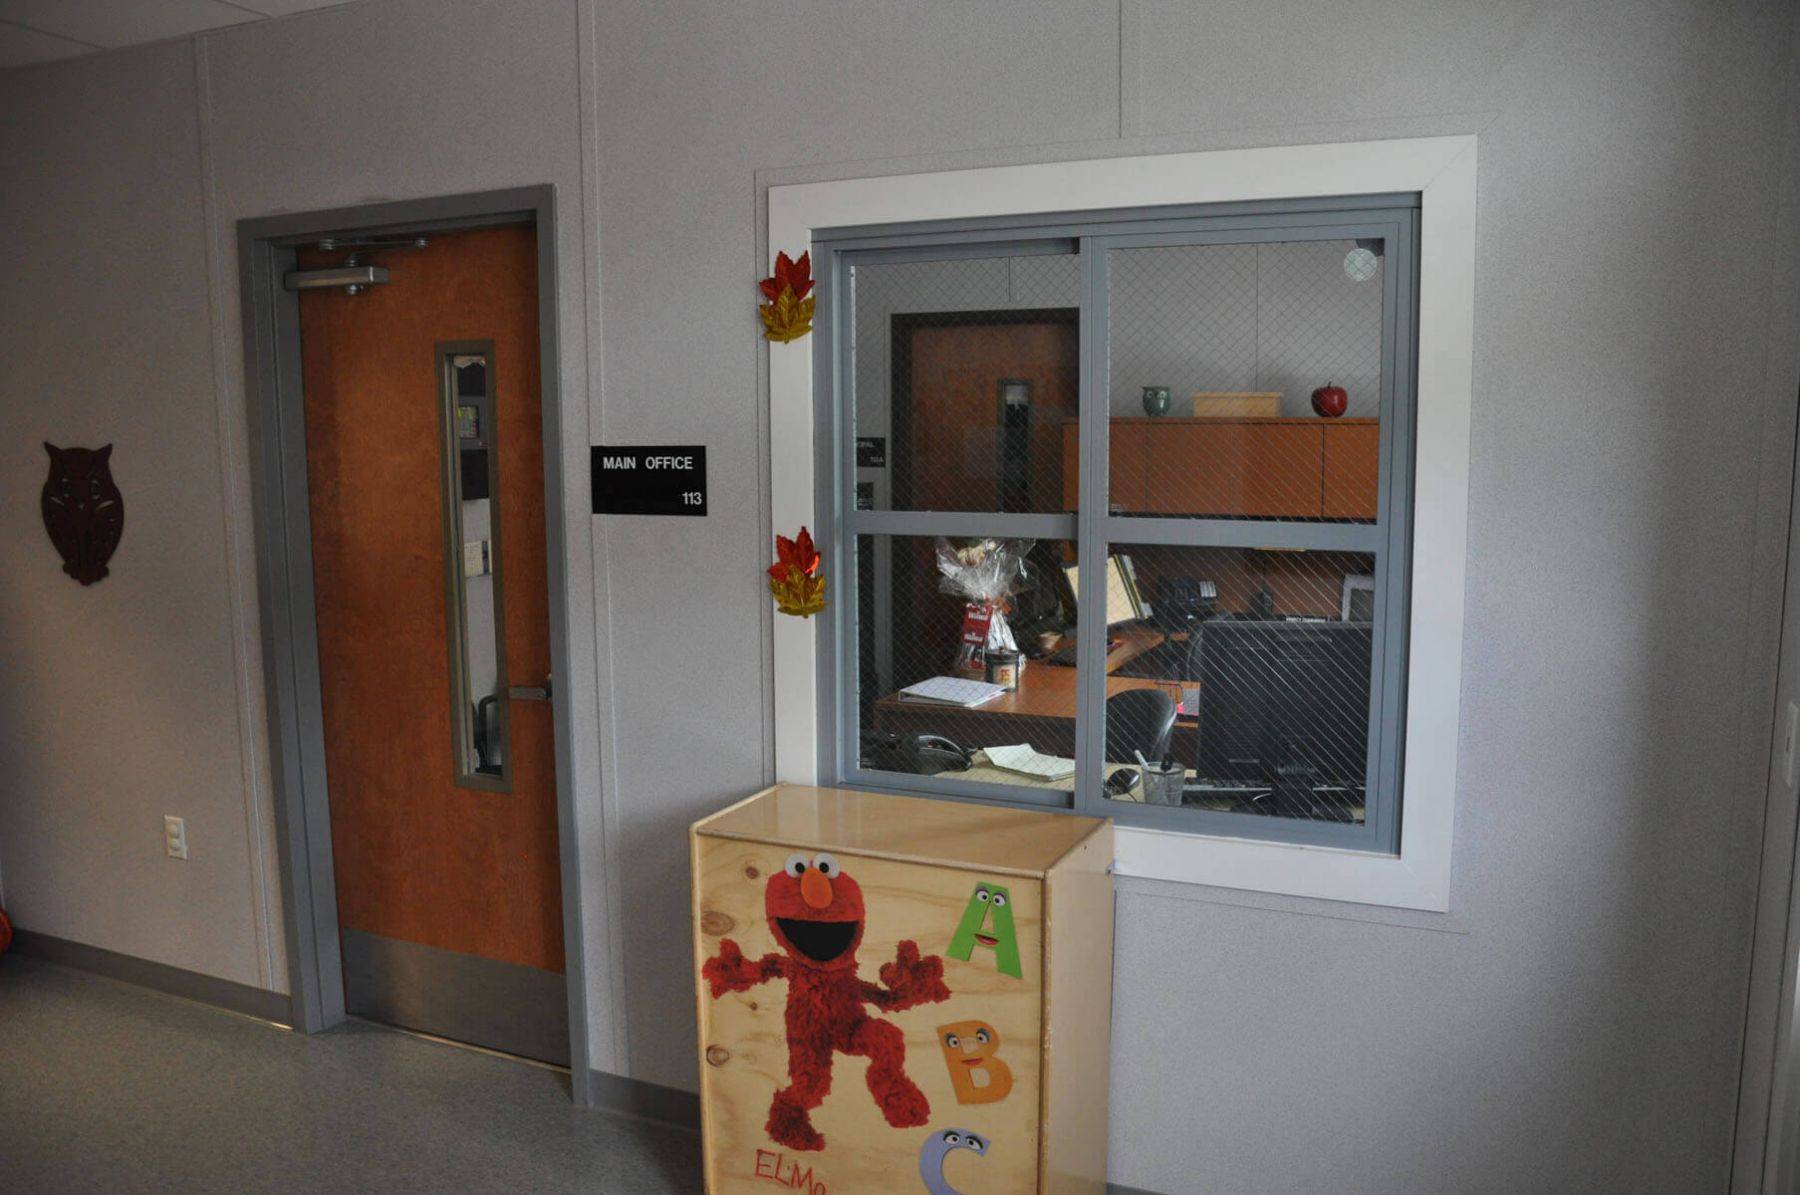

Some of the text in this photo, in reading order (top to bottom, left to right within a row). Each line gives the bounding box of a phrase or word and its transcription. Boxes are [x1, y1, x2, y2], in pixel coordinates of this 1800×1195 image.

[603, 456, 694, 470] MAIN OFFICE
[682, 491, 703, 505] 113
[945, 881, 1023, 980] A
[936, 1020, 1014, 1105] B
[919, 1128, 992, 1195] C
